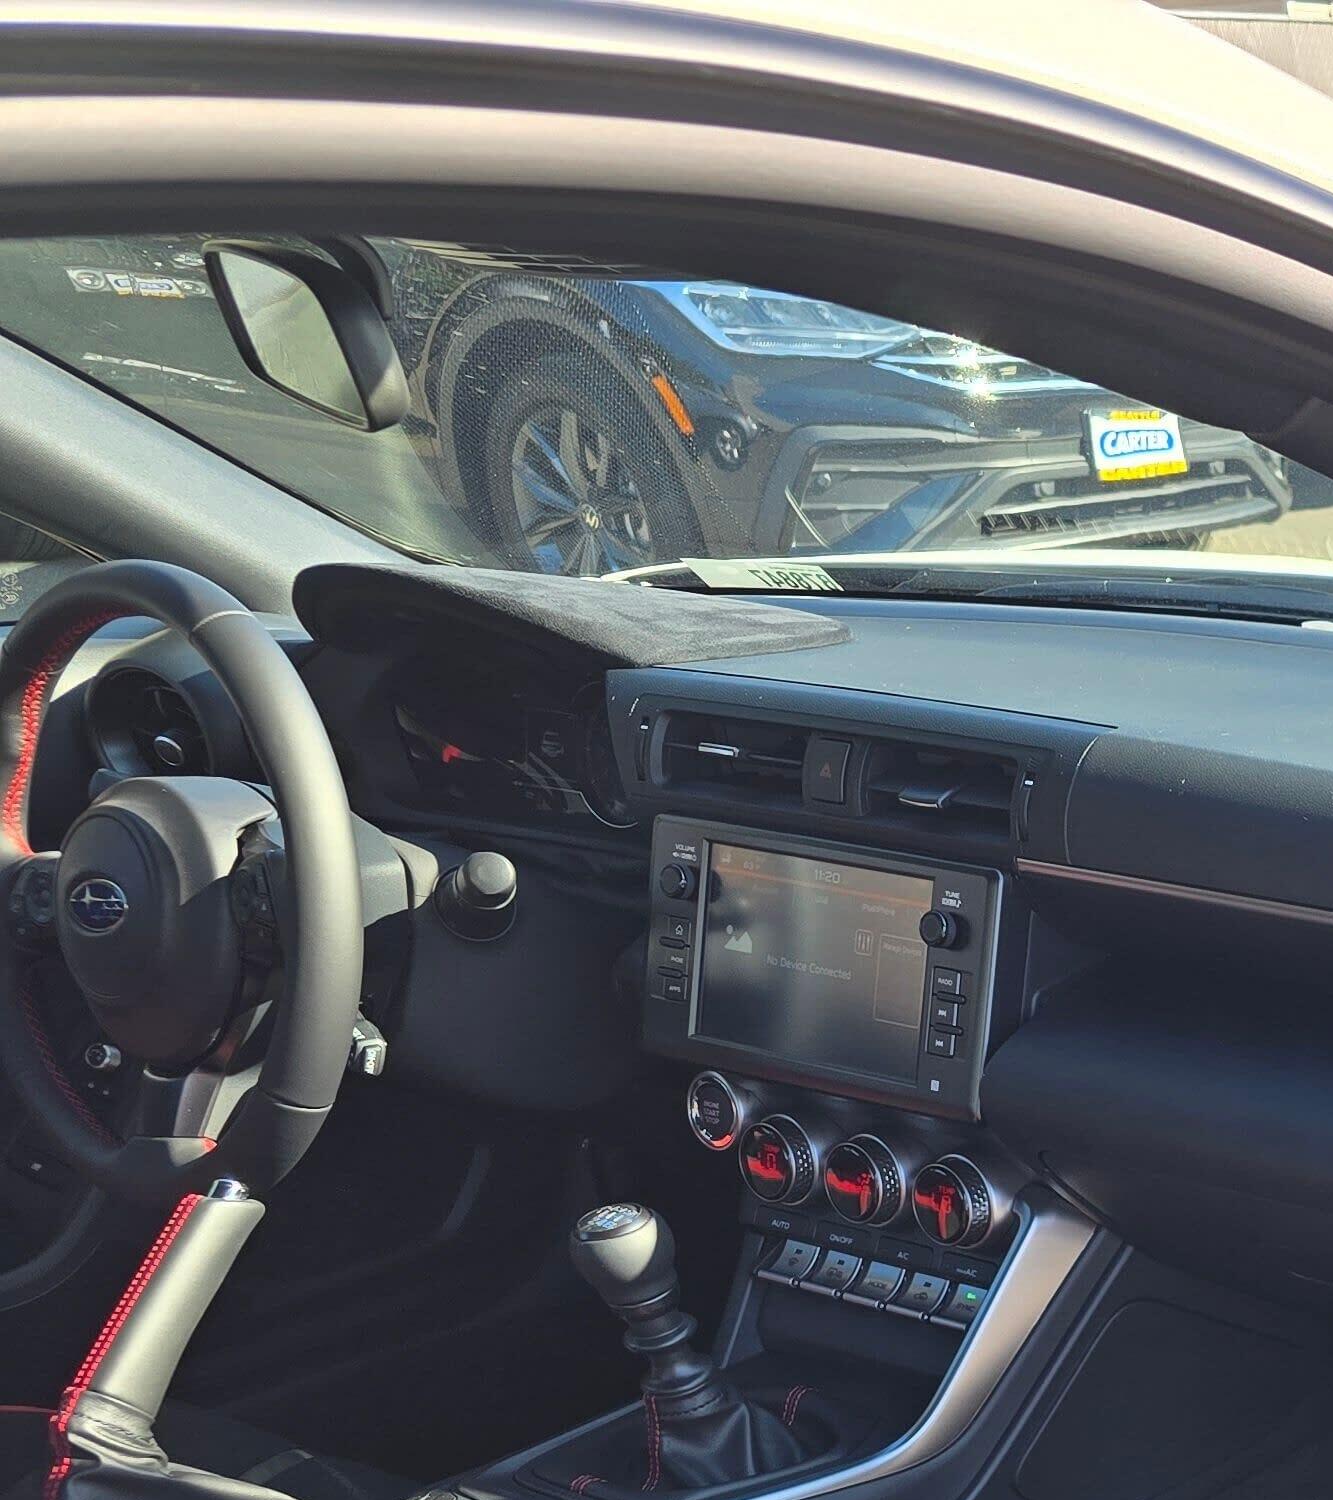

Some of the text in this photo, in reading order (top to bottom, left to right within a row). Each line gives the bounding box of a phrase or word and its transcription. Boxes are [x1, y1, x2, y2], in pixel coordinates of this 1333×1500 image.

[1103, 430, 1169, 456] CARTER
[814, 869, 840, 884] 11:20
[766, 954, 850, 980] No Device Connected
[771, 1219, 790, 1230] AUTO
